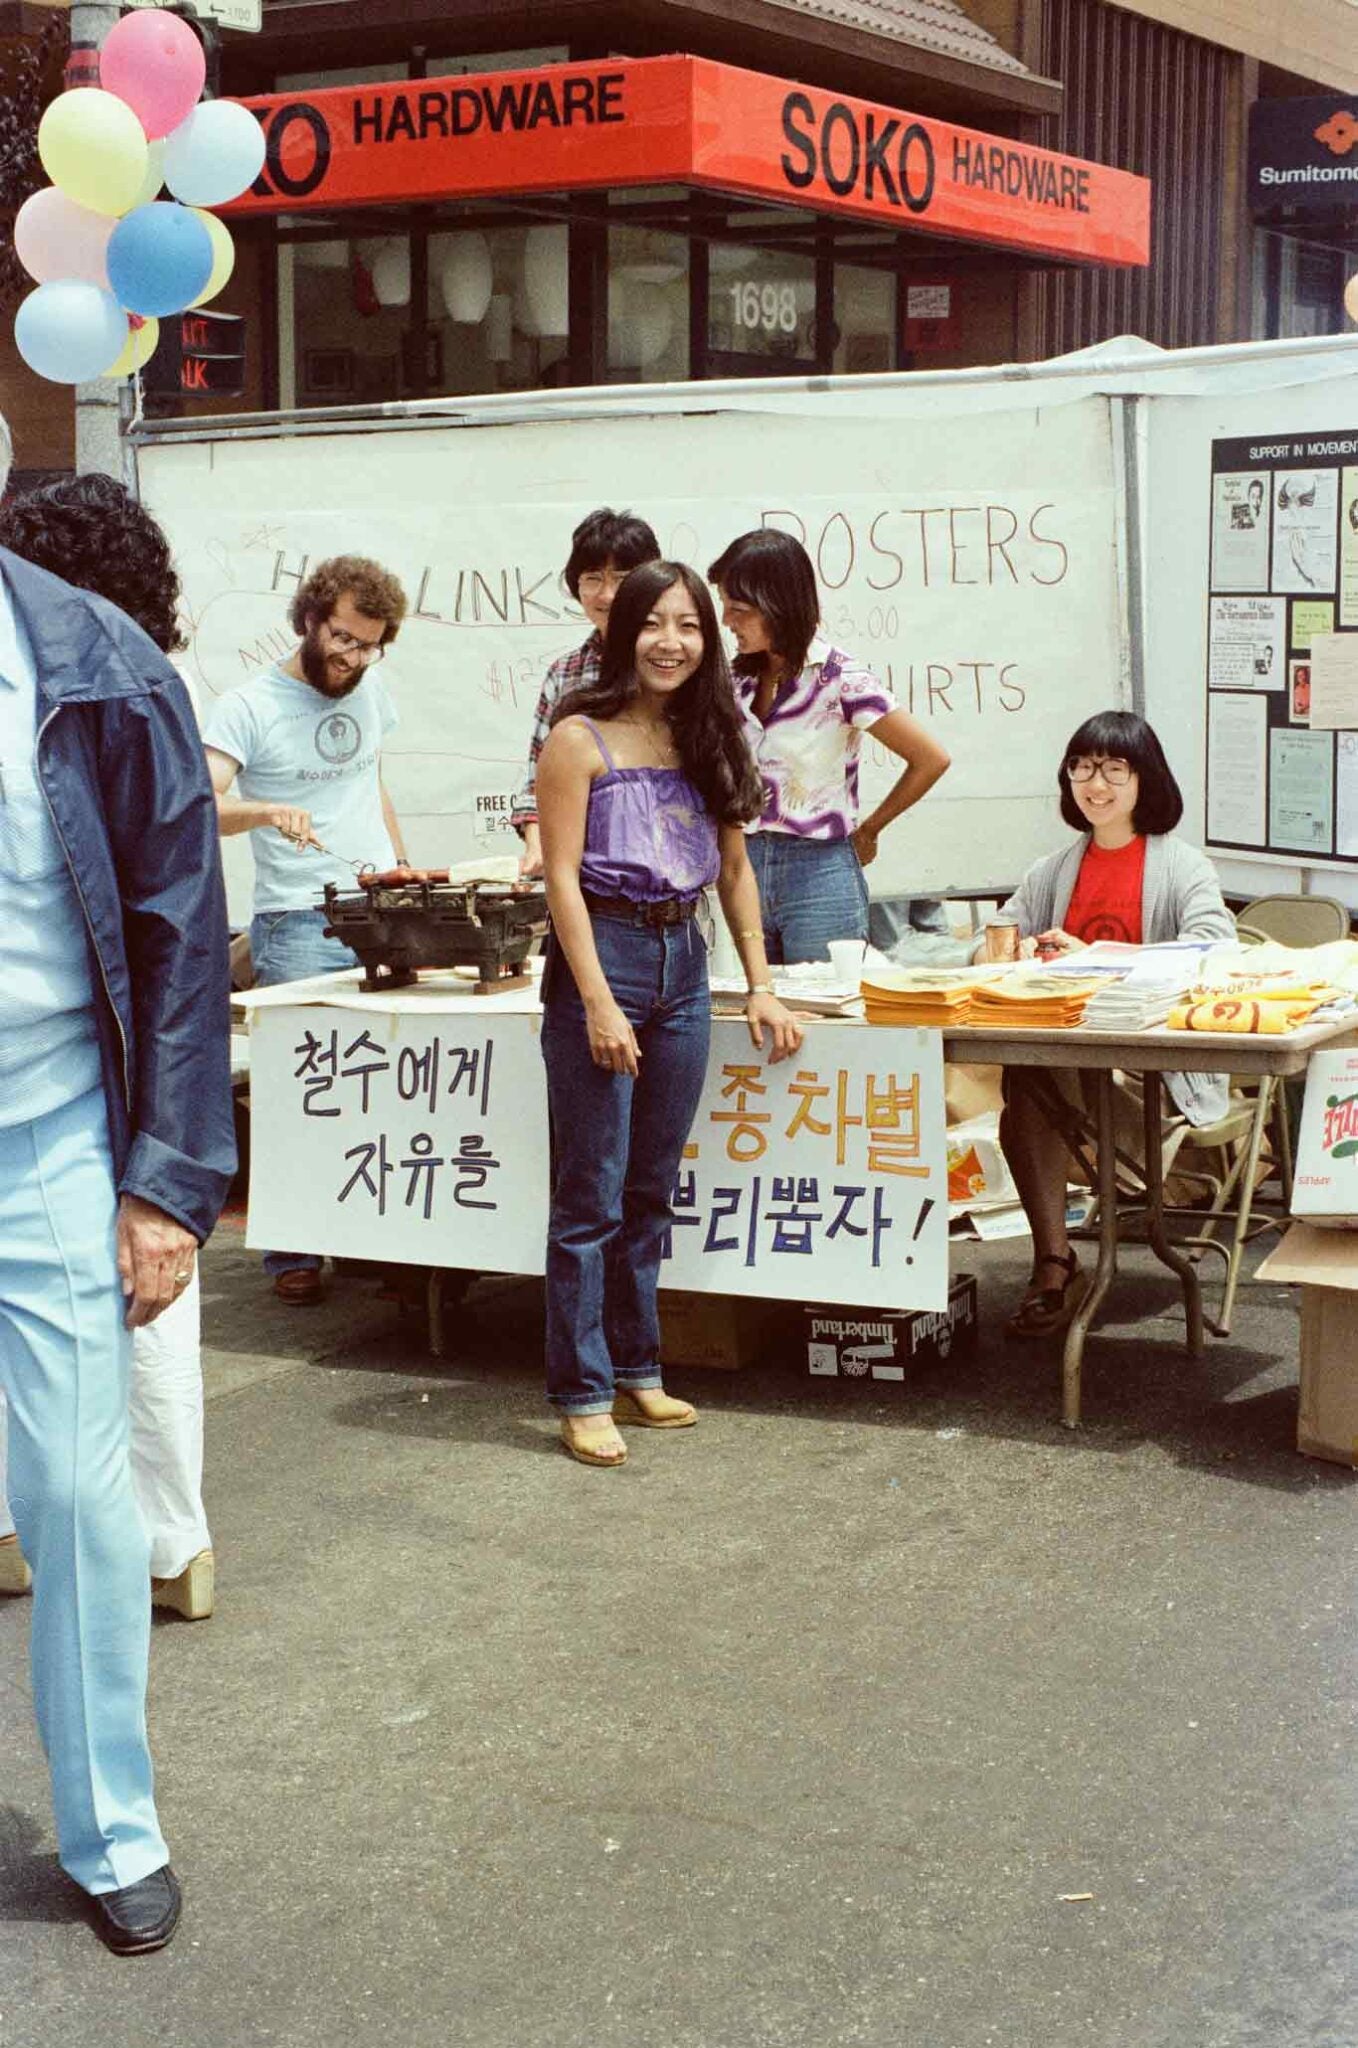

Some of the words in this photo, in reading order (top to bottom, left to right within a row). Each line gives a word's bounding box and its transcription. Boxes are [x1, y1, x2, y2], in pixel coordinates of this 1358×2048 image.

[353, 74, 626, 144] HARDWARE
[780, 92, 936, 213] SOKO
[952, 136, 1091, 213] HARDWARE
[730, 281, 798, 333] 1698
[1249, 444, 1289, 460] SUPPORT
[1293, 443, 1303, 457] IN
[1307, 440, 1358, 456] MOVEMEN
[867, 662, 1027, 715] IRTS
[476, 795, 506, 812] FREE
[294, 1029, 493, 1117] 철수에게
[682, 1063, 931, 1178] 종차별
[337, 1133, 500, 1219] 자유를
[811, 1319, 898, 1345] Timberland
